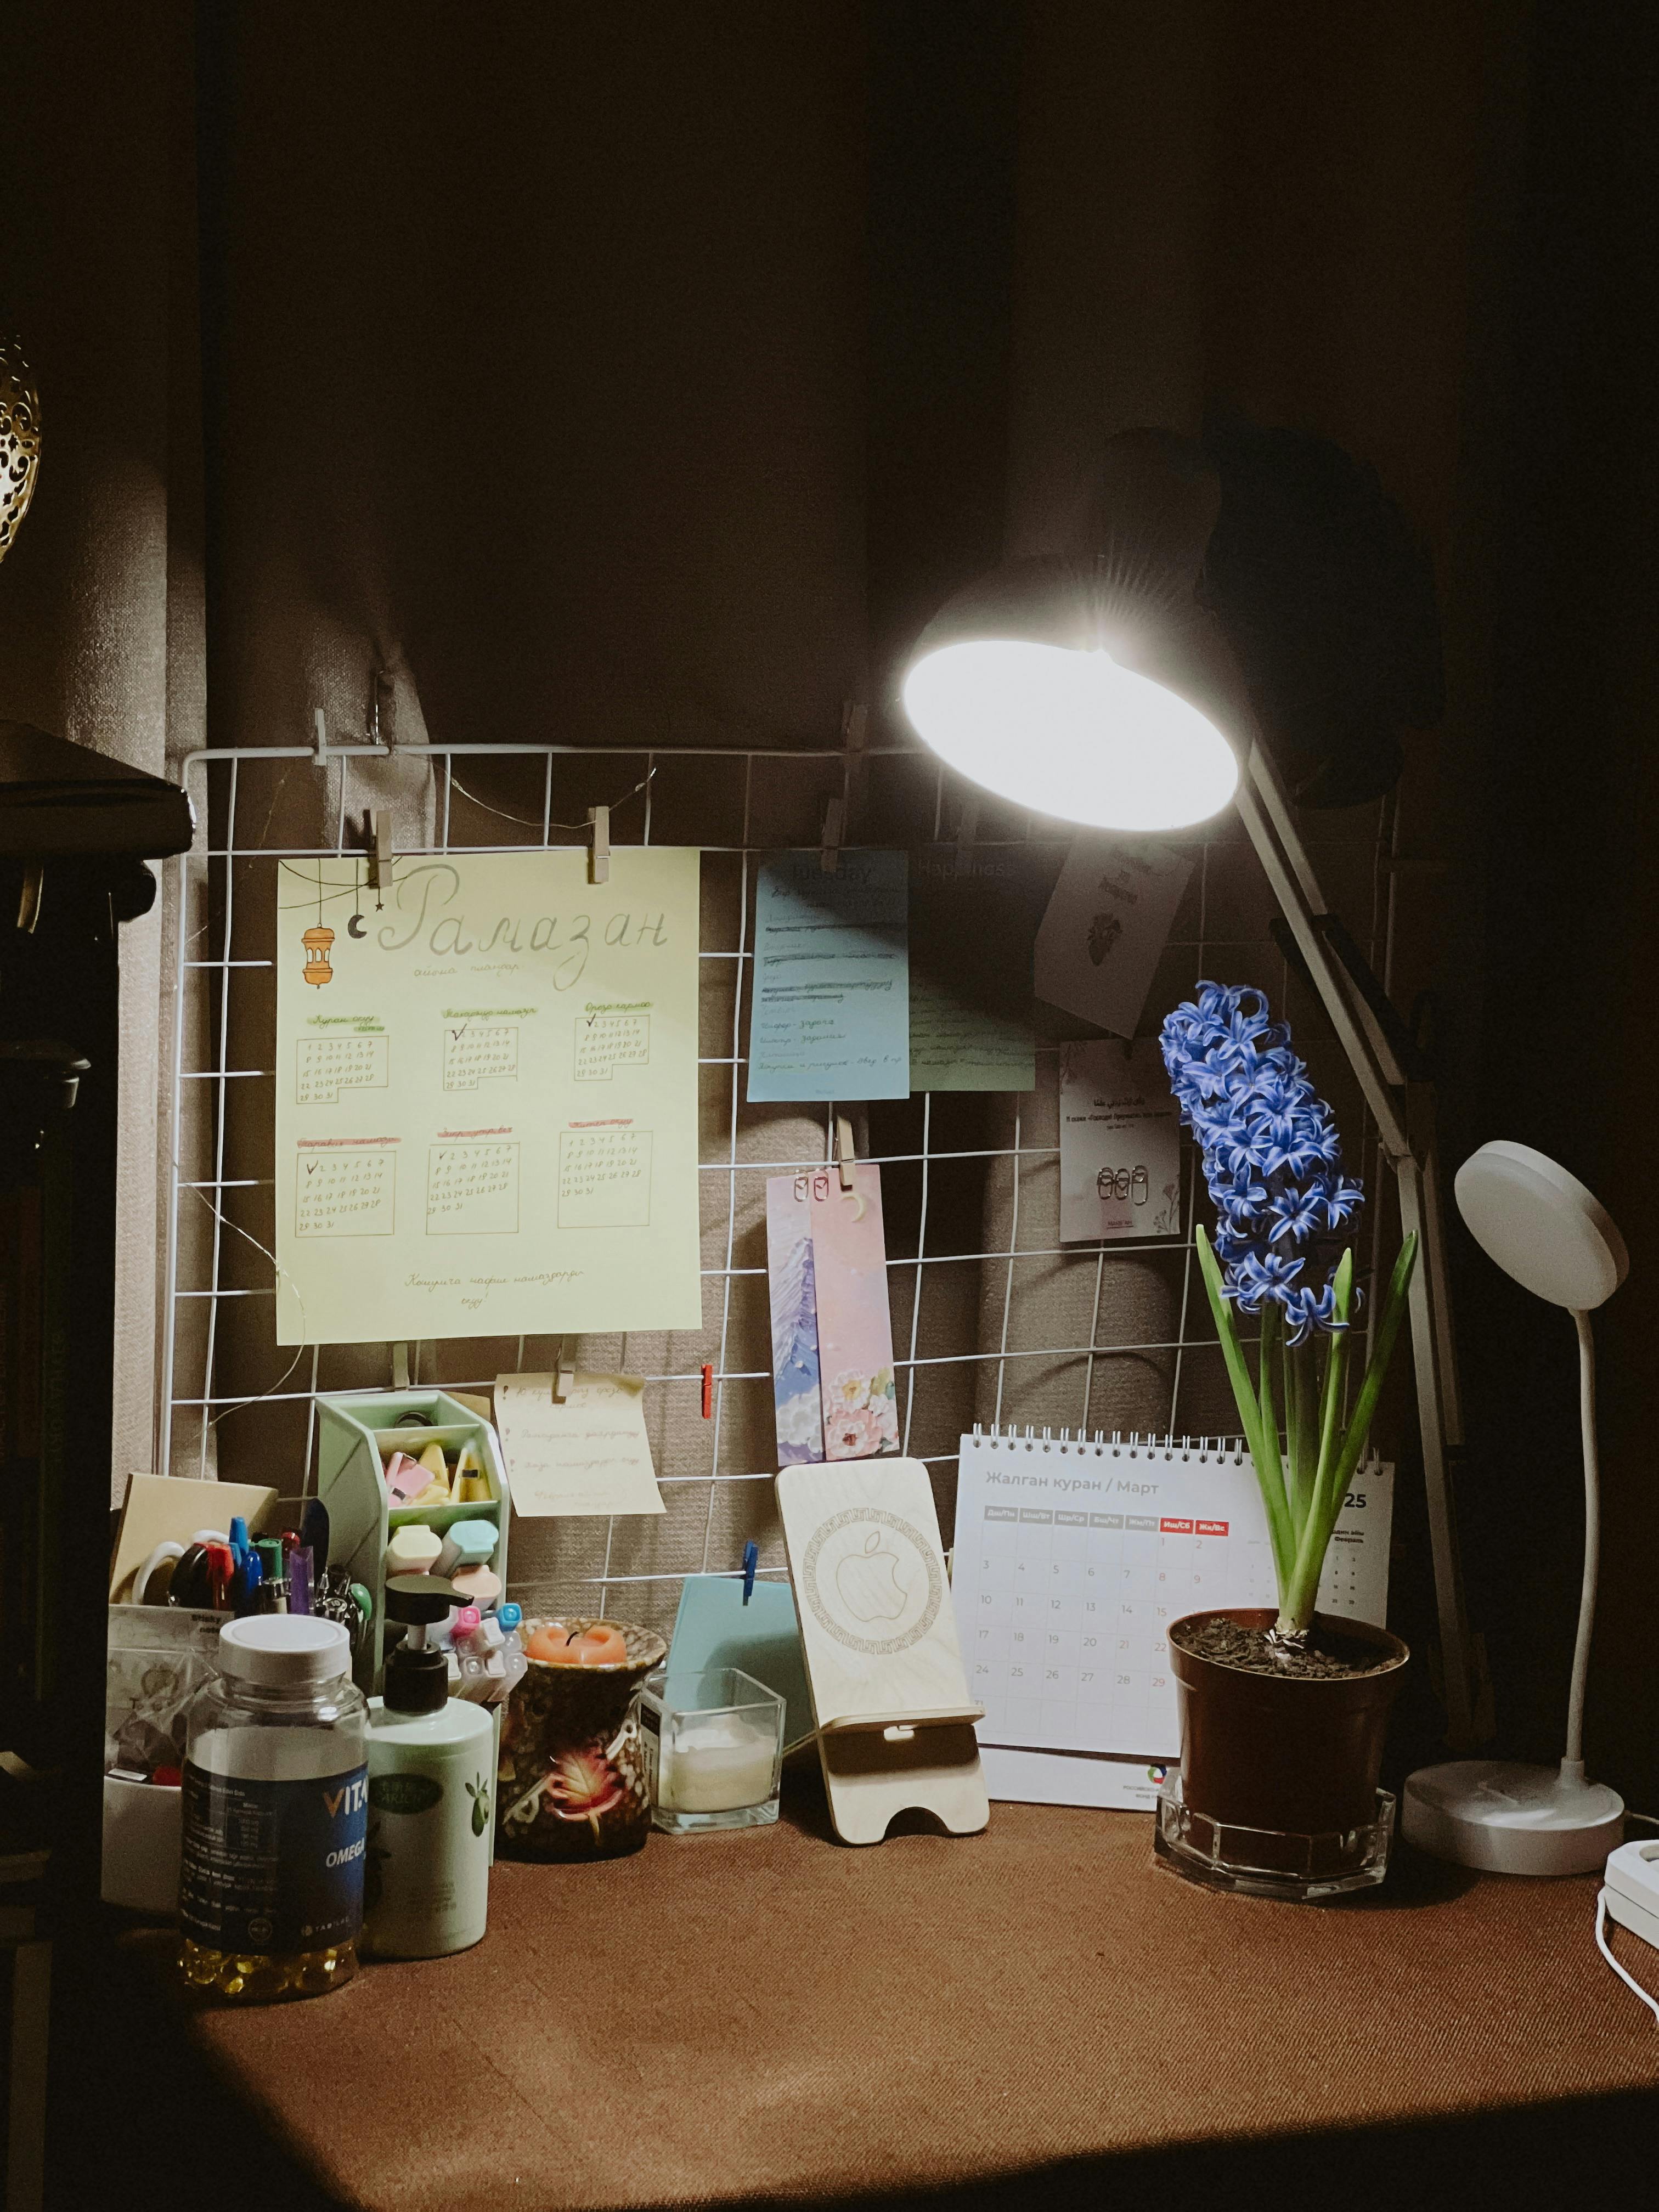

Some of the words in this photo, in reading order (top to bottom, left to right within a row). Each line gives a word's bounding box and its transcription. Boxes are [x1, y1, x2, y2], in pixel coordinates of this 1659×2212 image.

[377, 864, 668, 991] Рамазан
[371, 1200, 381, 1208] 28
[986, 1471, 1048, 1487] Жалган
[1054, 1479, 1101, 1491] куран
[1117, 1481, 1159, 1496] Март
[1344, 1493, 1367, 1508] 25
[1161, 1538, 1165, 1546] 1
[1196, 1541, 1203, 1549] 2
[983, 1560, 989, 1568] 3
[1053, 1565, 1059, 1574] 5
[1088, 1568, 1094, 1576] 6
[1124, 1570, 1130, 1578] 7
[1159, 1573, 1166, 1581] 8
[1194, 1575, 1200, 1583] 9
[981, 1595, 992, 1604] 10
[1016, 1598, 1023, 1606] 11
[1051, 1600, 1061, 1609] 12
[1087, 1602, 1096, 1611] 13
[1122, 1605, 1132, 1614] 14
[1157, 1607, 1167, 1616] 15
[979, 1630, 989, 1639] 17
[1014, 1633, 1024, 1641] 18
[1049, 1635, 1059, 1644] 19
[1084, 1638, 1097, 1646] 20
[1119, 1640, 1129, 1649] 21
[1155, 1643, 1167, 1652] 22
[976, 1665, 989, 1673] 24
[1011, 1668, 1023, 1677] 25
[1046, 1671, 1059, 1679] 26
[1081, 1673, 1094, 1681] 27
[1117, 1675, 1130, 1684] 28
[1153, 1678, 1165, 1686] 29
